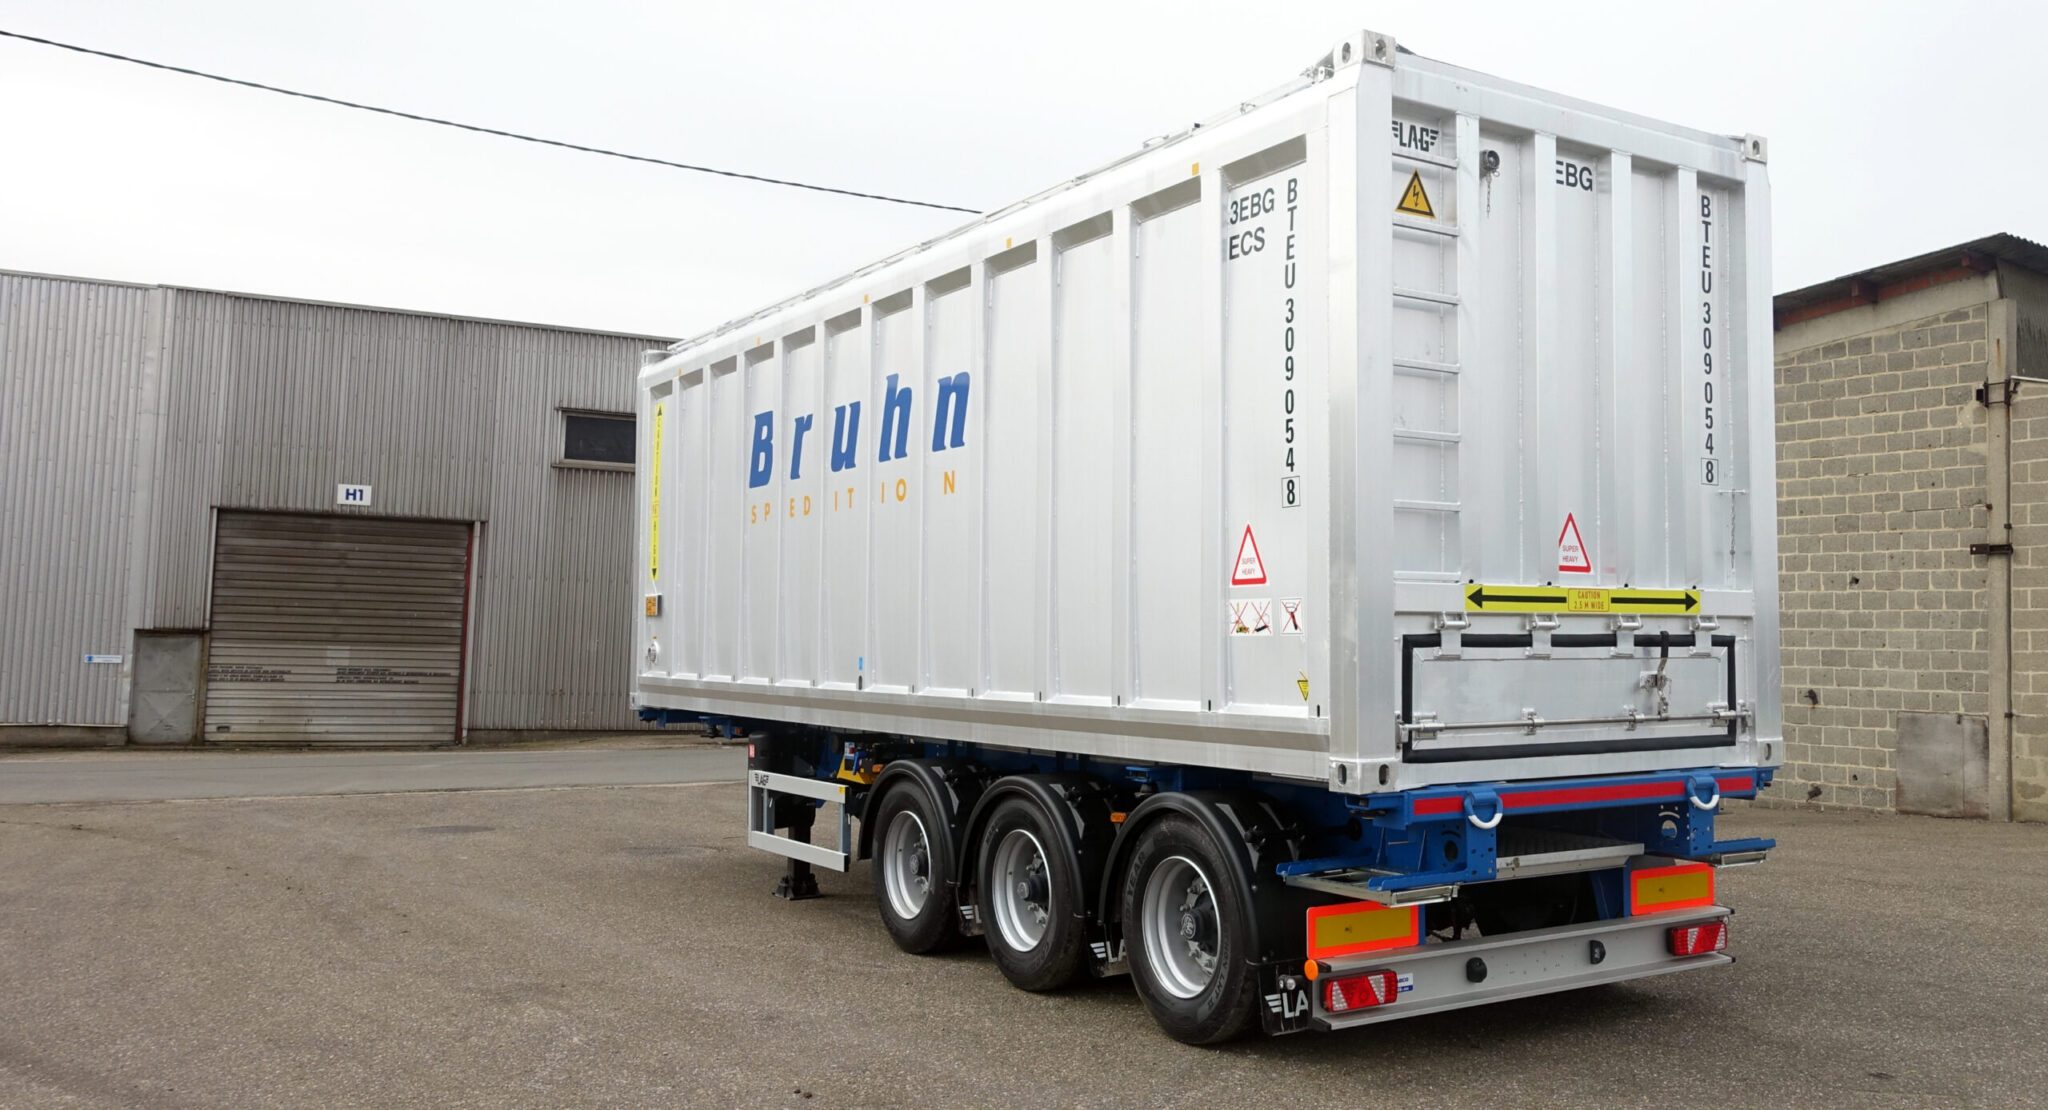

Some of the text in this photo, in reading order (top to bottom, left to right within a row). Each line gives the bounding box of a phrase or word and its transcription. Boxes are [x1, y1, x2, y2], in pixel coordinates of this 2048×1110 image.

[1399, 121, 1430, 152] LAG
[1229, 187, 1275, 226] 3EBG
[1228, 227, 1266, 260] ECS
[749, 371, 971, 489] Bruhn
[345, 488, 364, 501] H1
[751, 470, 956, 525] SPEDITION
[1577, 590, 1601, 599] CAUTION
